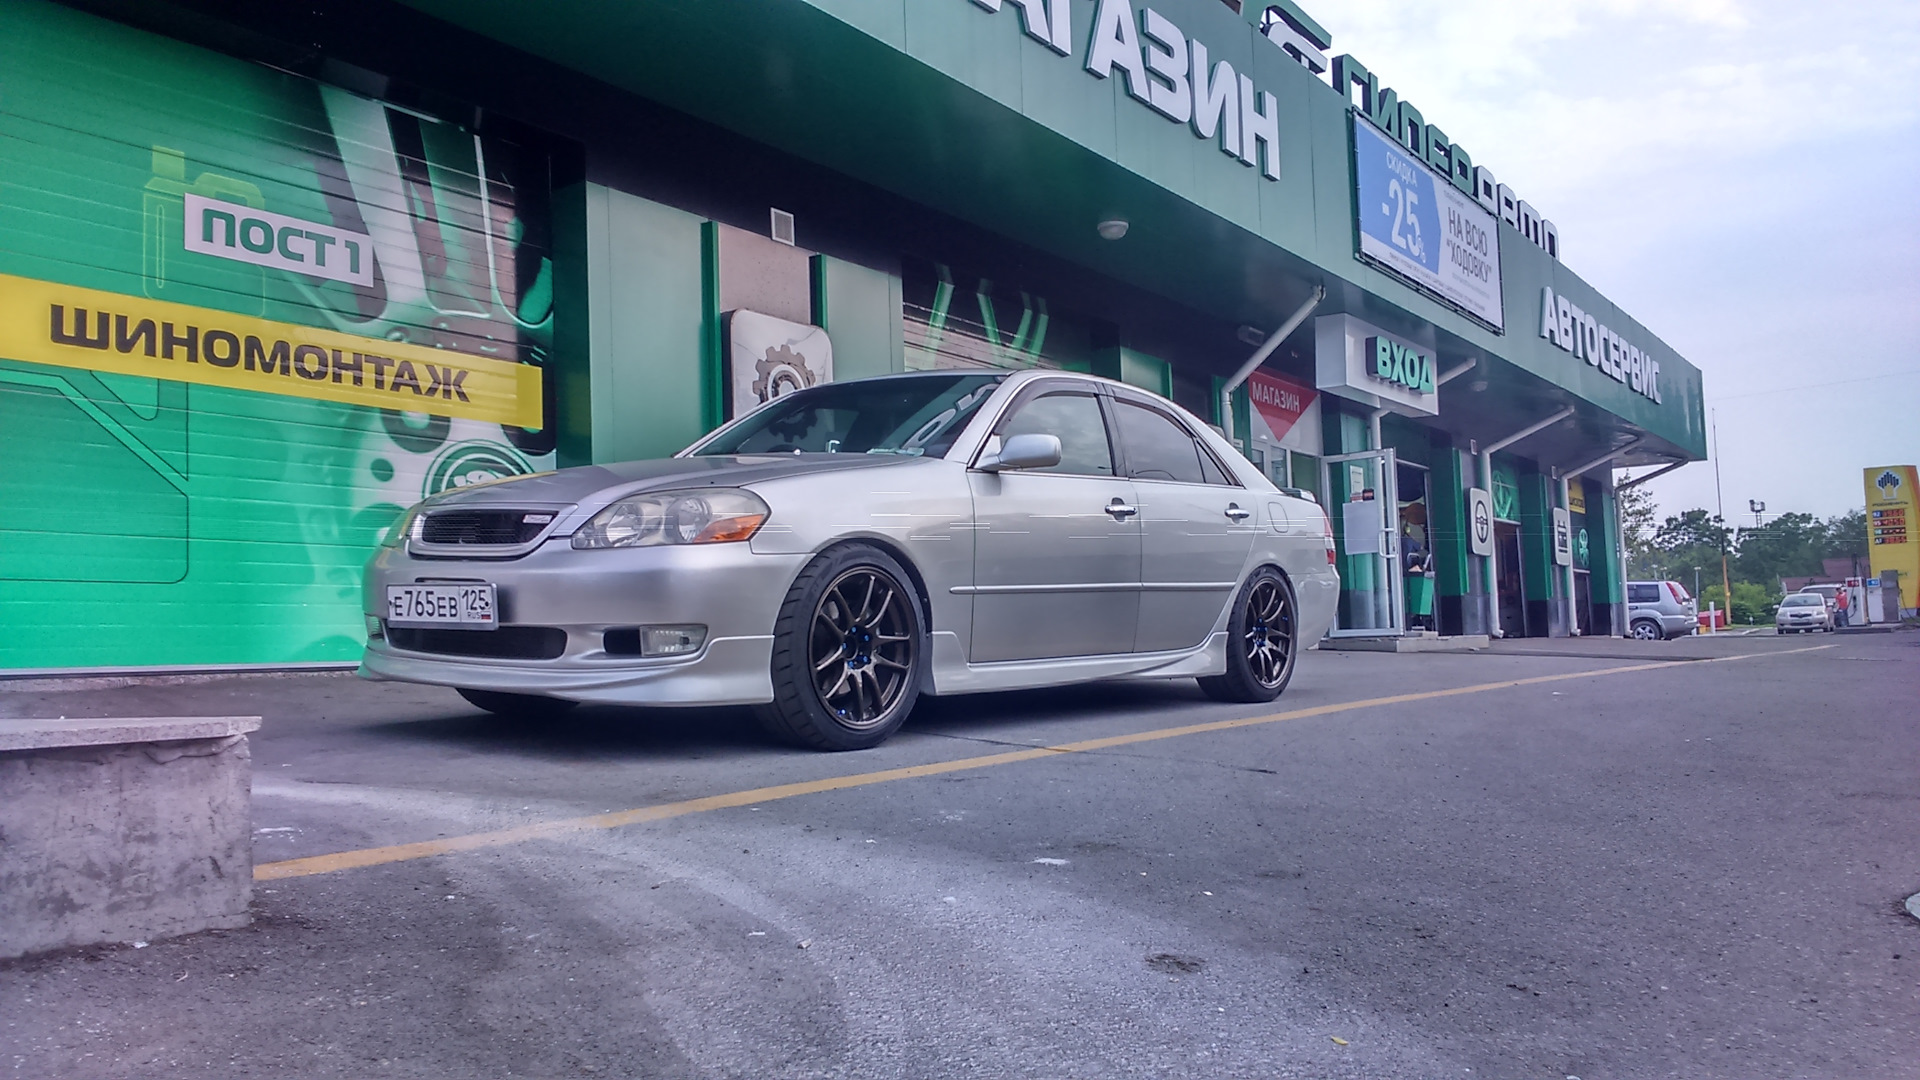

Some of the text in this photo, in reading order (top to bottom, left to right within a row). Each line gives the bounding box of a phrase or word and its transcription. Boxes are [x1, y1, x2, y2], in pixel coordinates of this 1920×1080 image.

[1386, 151, 1418, 188] СКИДКА
[202, 207, 361, 274] ПОСТ 1
[1447, 206, 1488, 257] НА ВСЮ
[50, 303, 471, 403] ШИНОМОНТАЖ
[1373, 335, 1435, 395] ВХОД
[1540, 286, 1662, 405] АВТОСЕРВИС
[1252, 381, 1300, 413] МАГАЗИН
[394, 589, 488, 618] Е765ЕВ 125
[467, 611, 481, 619] RUS
